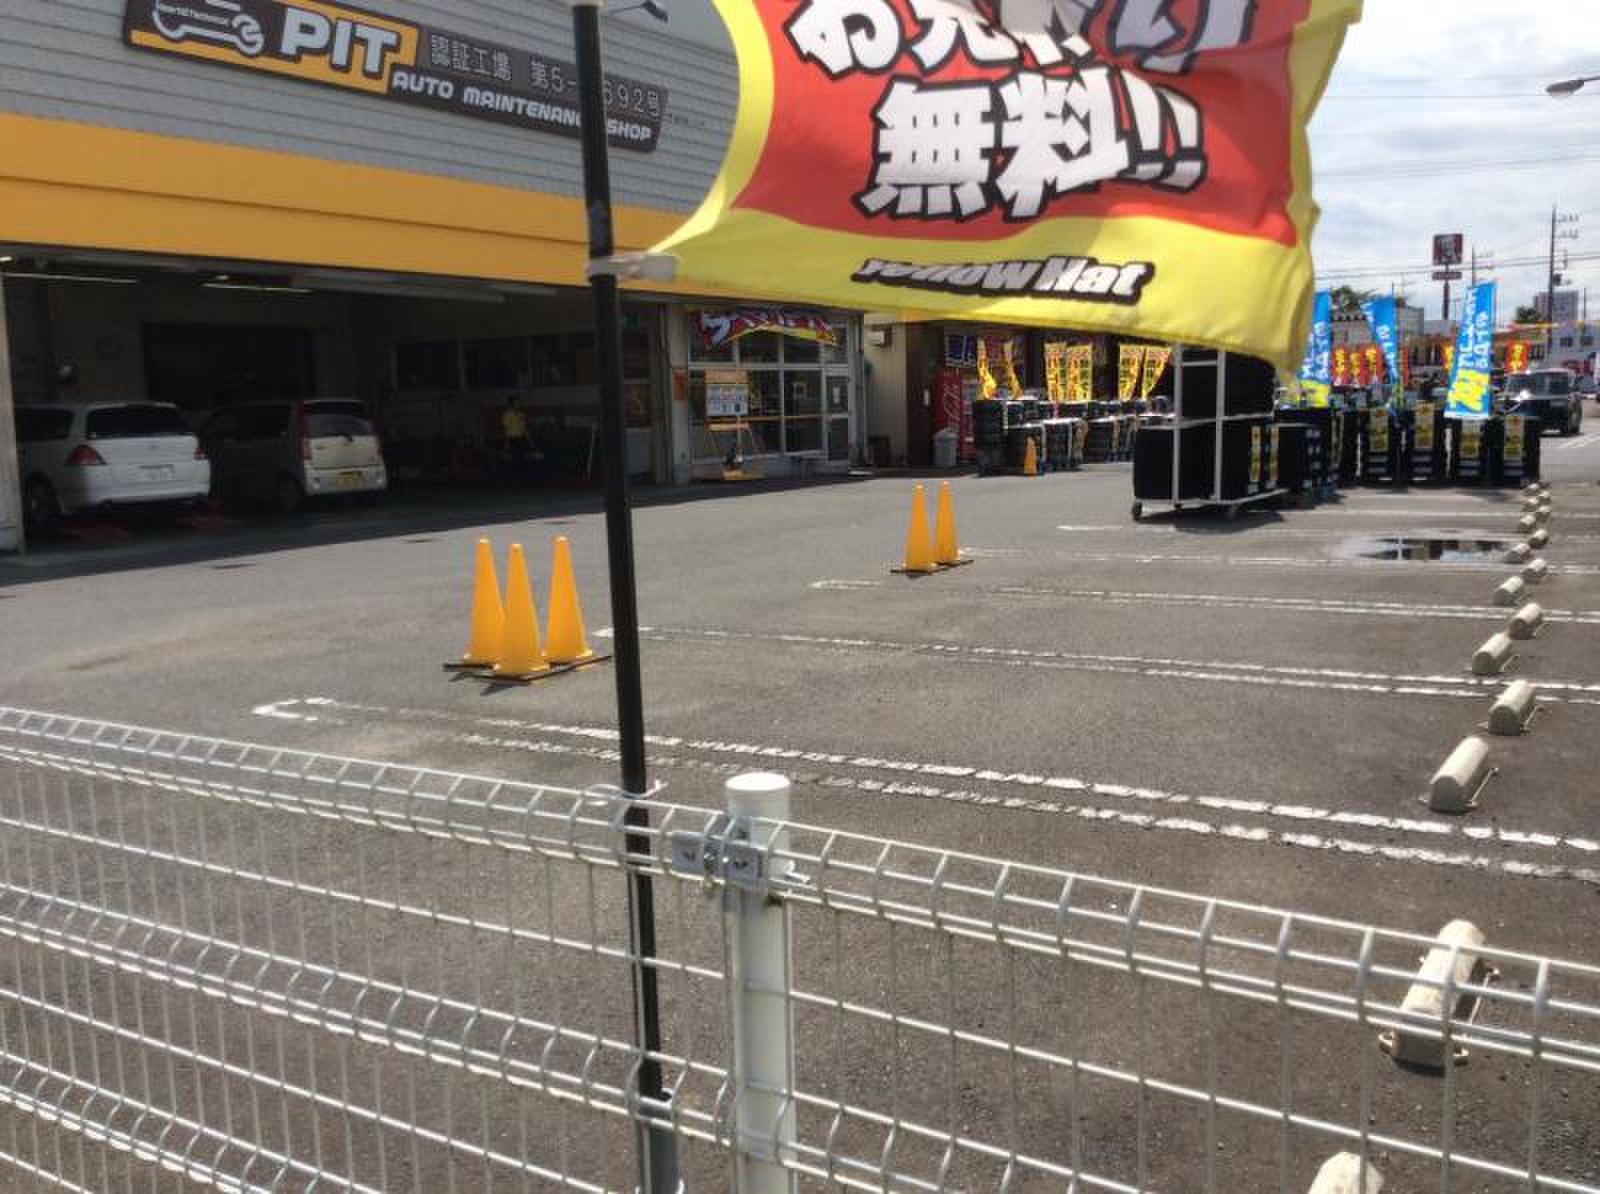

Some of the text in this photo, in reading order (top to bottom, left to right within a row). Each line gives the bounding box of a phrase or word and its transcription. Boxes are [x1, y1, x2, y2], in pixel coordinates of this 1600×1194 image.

[280, 8, 398, 73] PIT
[392, 71, 455, 98] AUTO
[608, 117, 653, 141] SHOP
[1036, 257, 1151, 300] Hat
